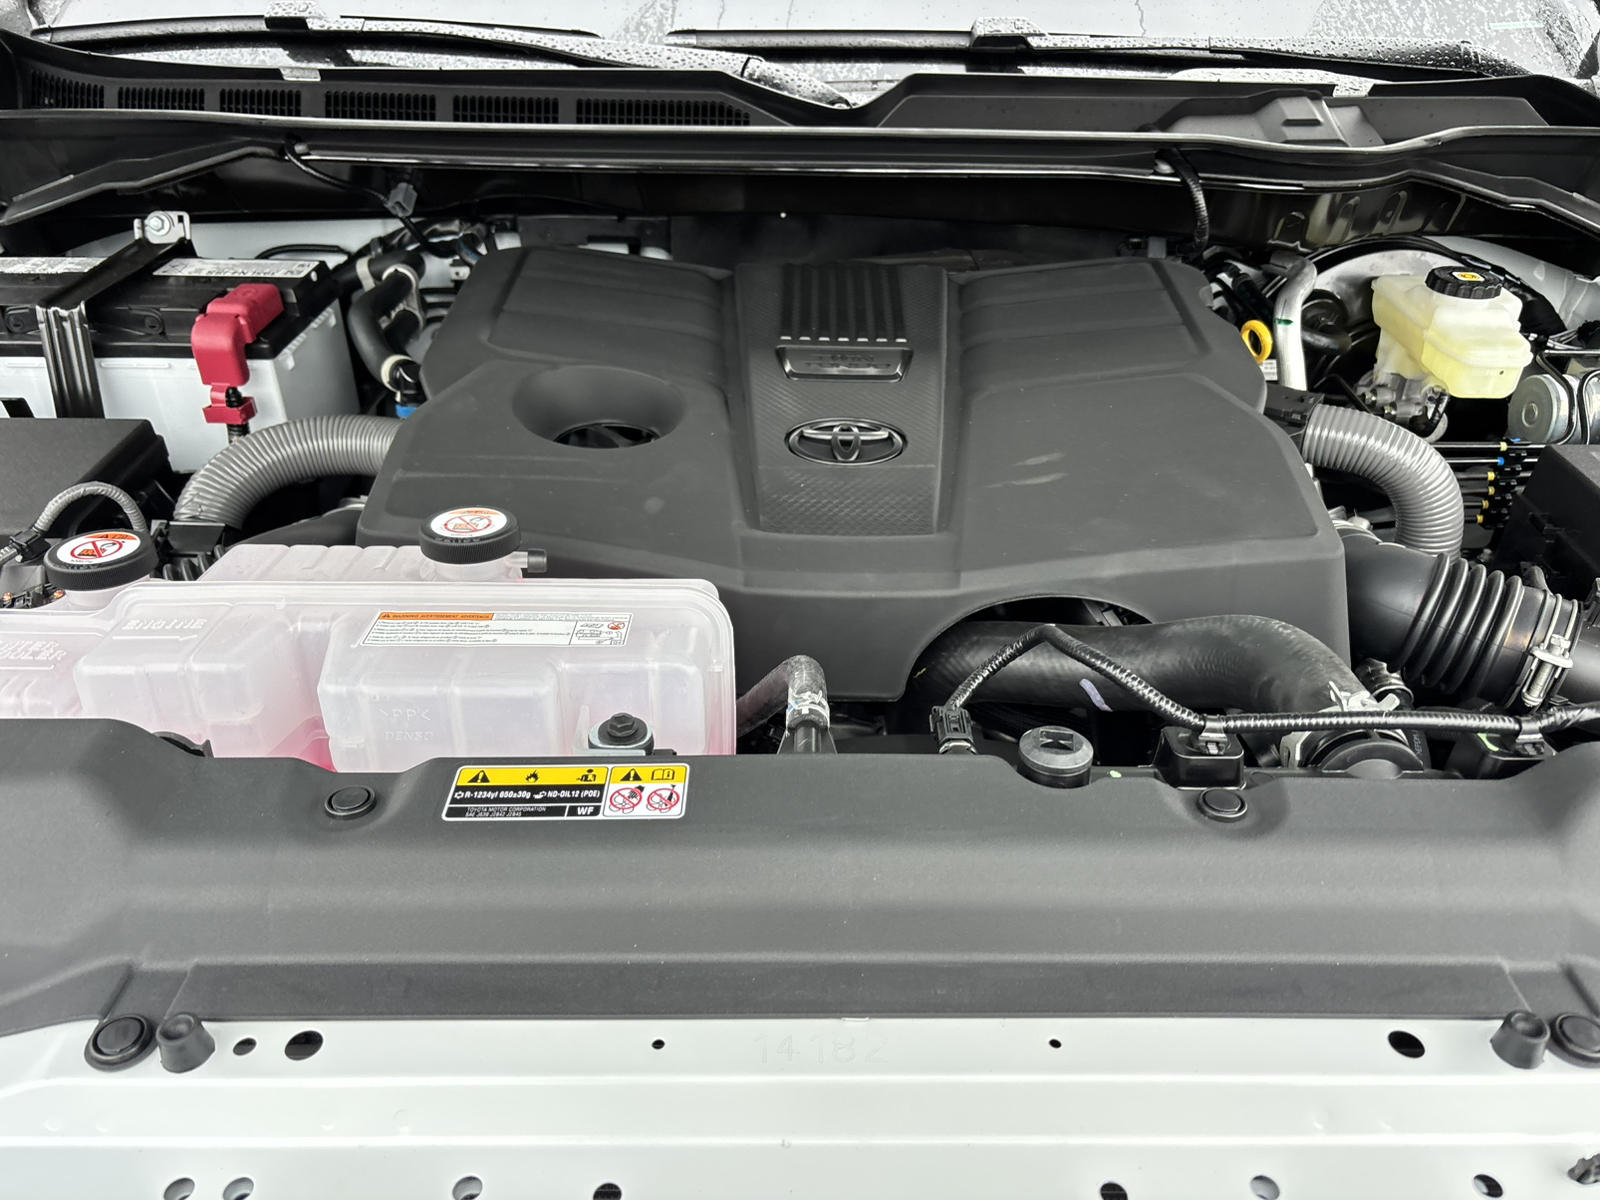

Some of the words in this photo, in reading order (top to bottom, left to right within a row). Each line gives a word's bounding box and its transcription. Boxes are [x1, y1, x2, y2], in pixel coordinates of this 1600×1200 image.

[121, 618, 208, 631] ENGINE
[464, 790, 499, 799] R-1234yf
[580, 789, 601, 798] (POE)
[577, 806, 595, 815] WF
